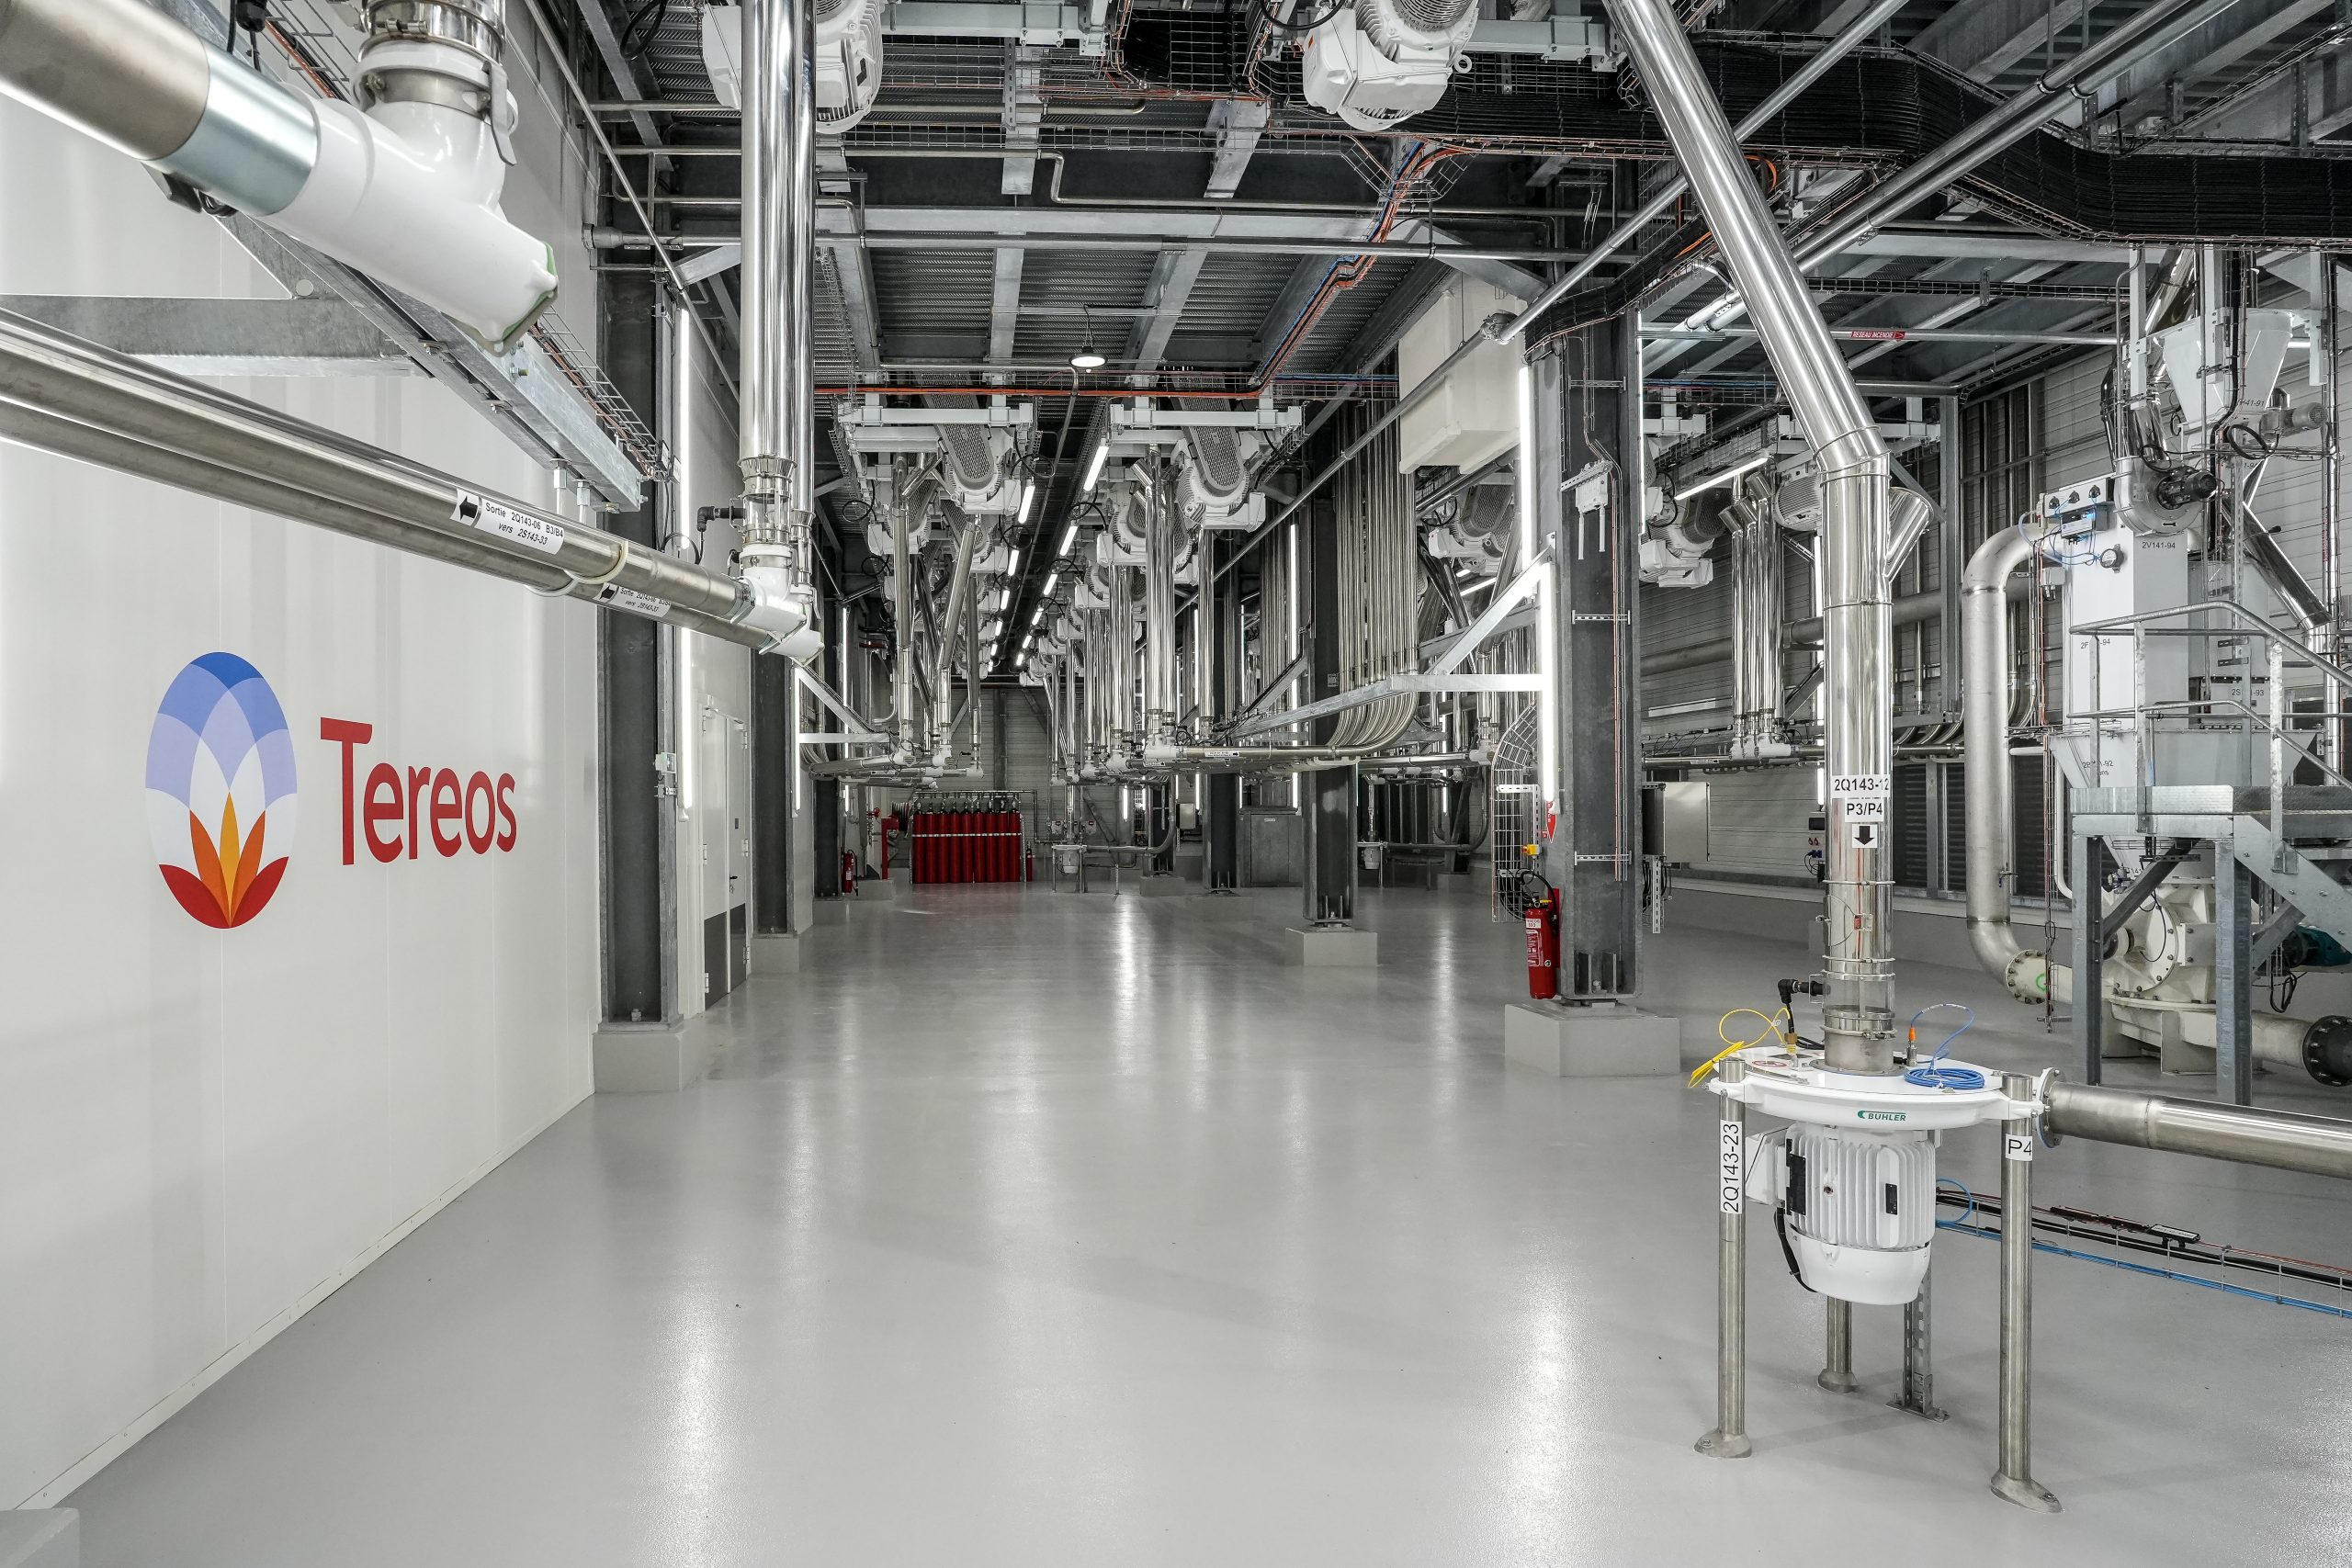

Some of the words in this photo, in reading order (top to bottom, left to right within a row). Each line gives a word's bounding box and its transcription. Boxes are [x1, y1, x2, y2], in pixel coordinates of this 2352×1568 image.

[485, 502, 506, 517] Sortie
[511, 512, 541, 530] 2Q143-06
[546, 525, 563, 537] B3/B4
[498, 523, 514, 533] vers
[517, 528, 548, 545] 2S143-33
[2142, 541, 2176, 549] 2V141-94
[2080, 638, 2110, 649] 2F-94
[320, 716, 517, 866] Tereos
[1834, 778, 1890, 792] 2Q143-12
[1847, 803, 1883, 816] P3/P4
[2008, 1139, 2032, 1156] P4
[1723, 1123, 1740, 1213] 2Q143-23
